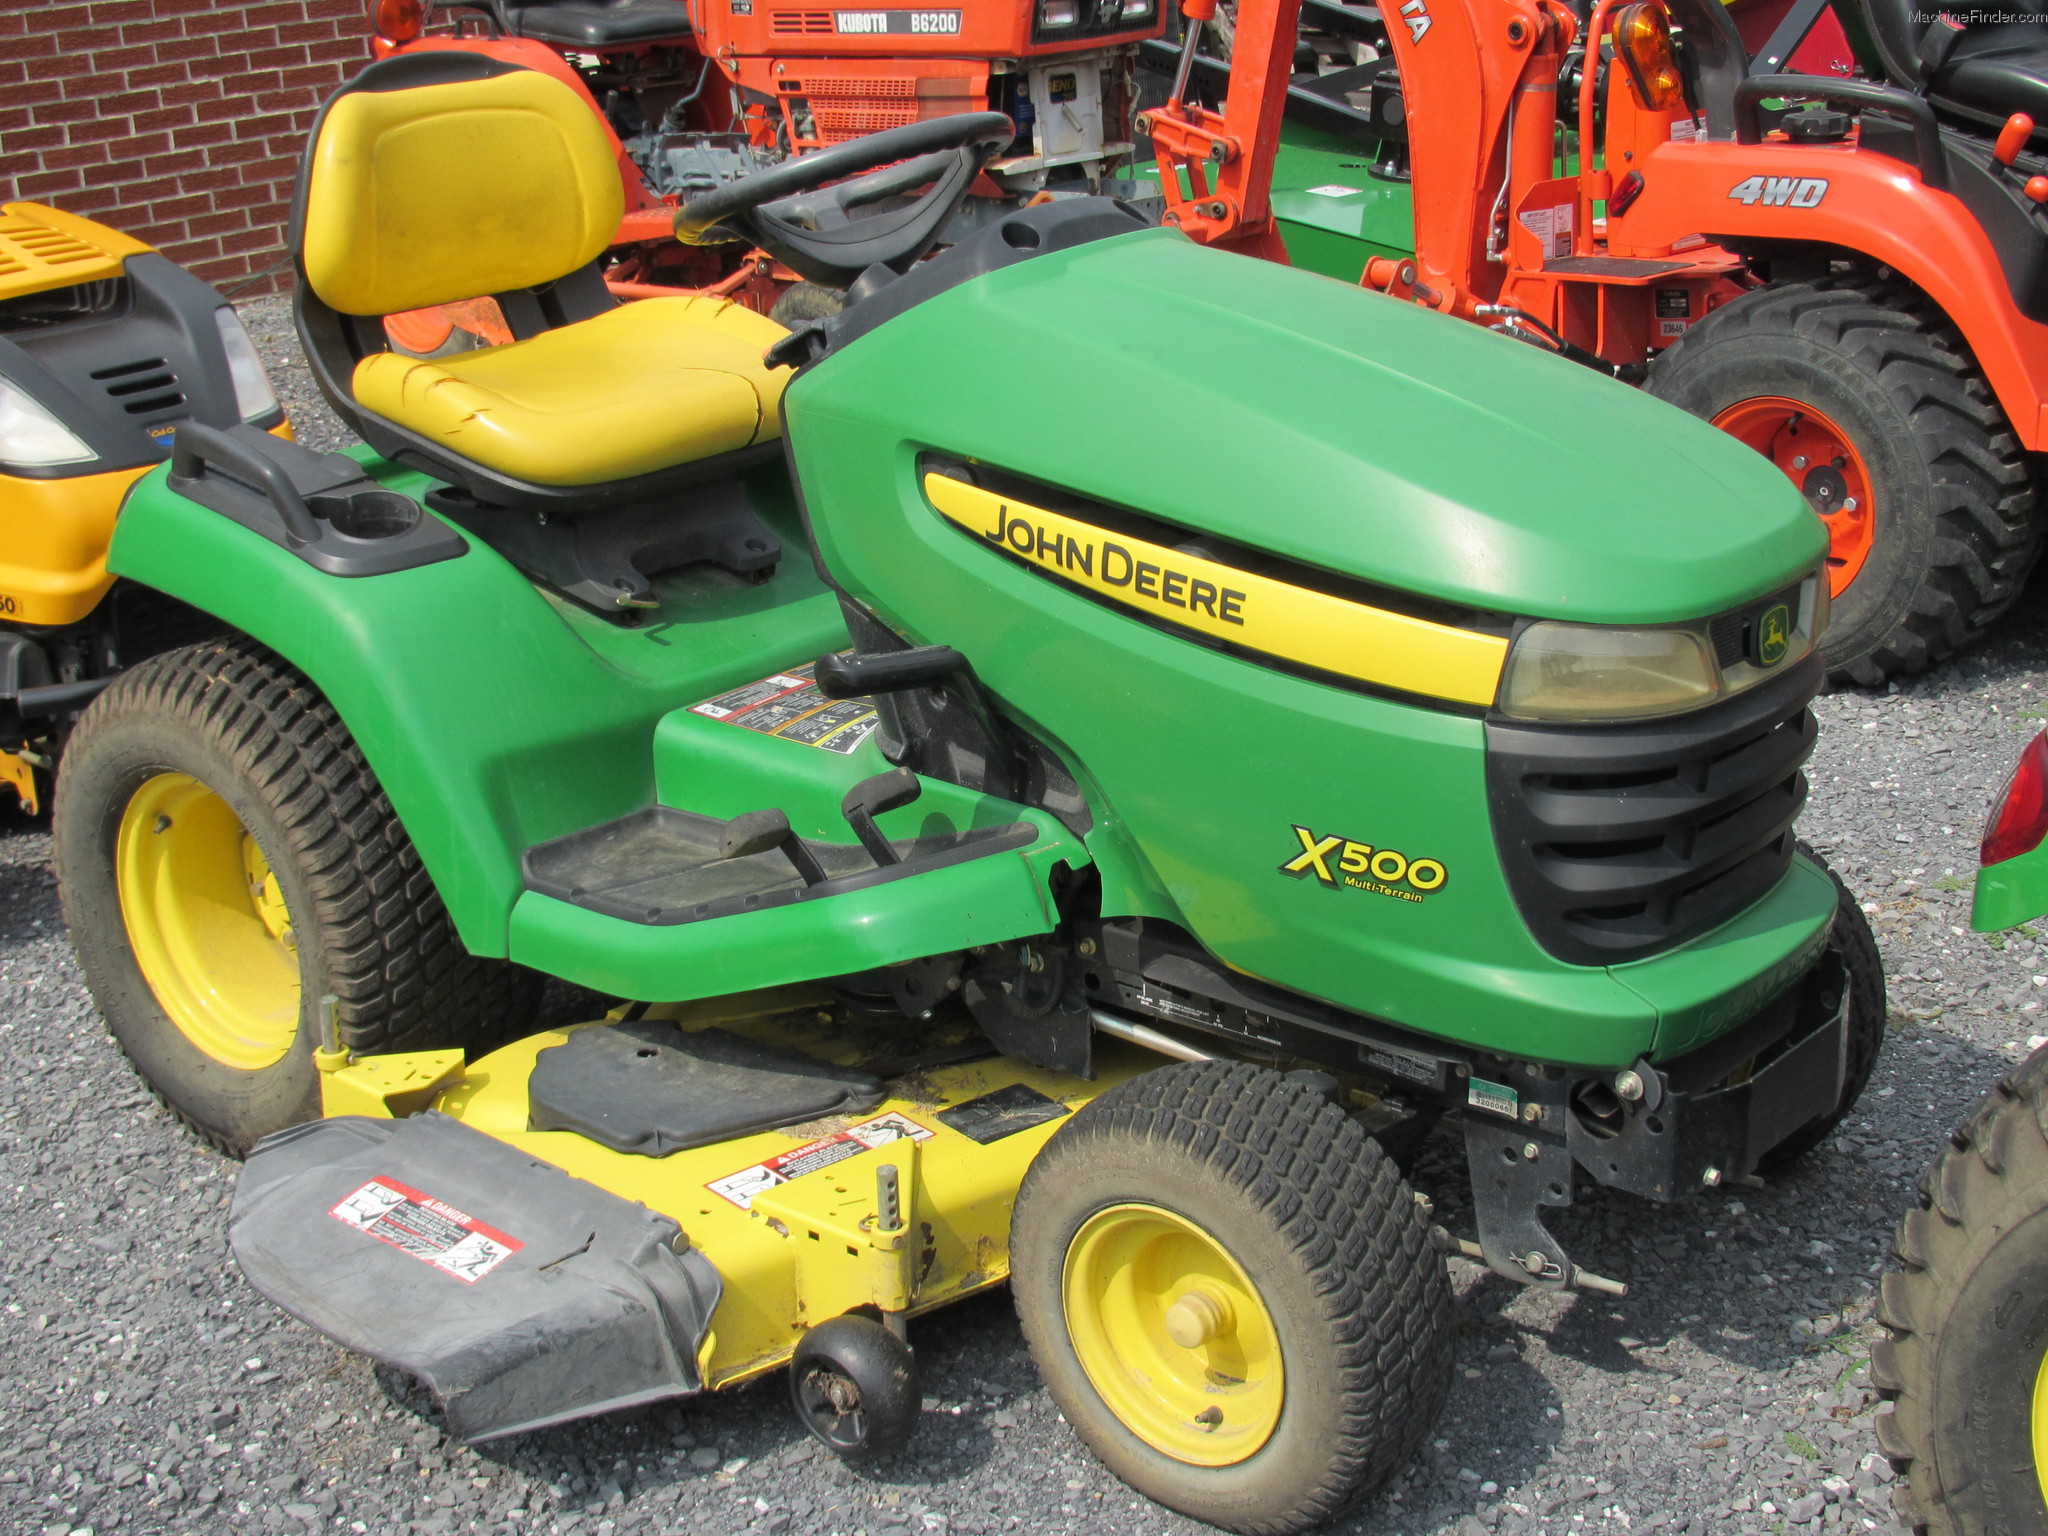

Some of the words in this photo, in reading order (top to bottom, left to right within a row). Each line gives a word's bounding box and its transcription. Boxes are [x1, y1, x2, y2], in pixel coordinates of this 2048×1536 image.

[838, 13, 887, 33] KUBOTA
[911, 13, 957, 32] B6200
[1727, 174, 1829, 208] 4WD
[986, 504, 1094, 577] JOHN
[1101, 541, 1246, 626] DEERE
[1277, 824, 1449, 893] X500
[1344, 876, 1424, 904] Multi-Terrain
[430, 1201, 473, 1226] DANGER
